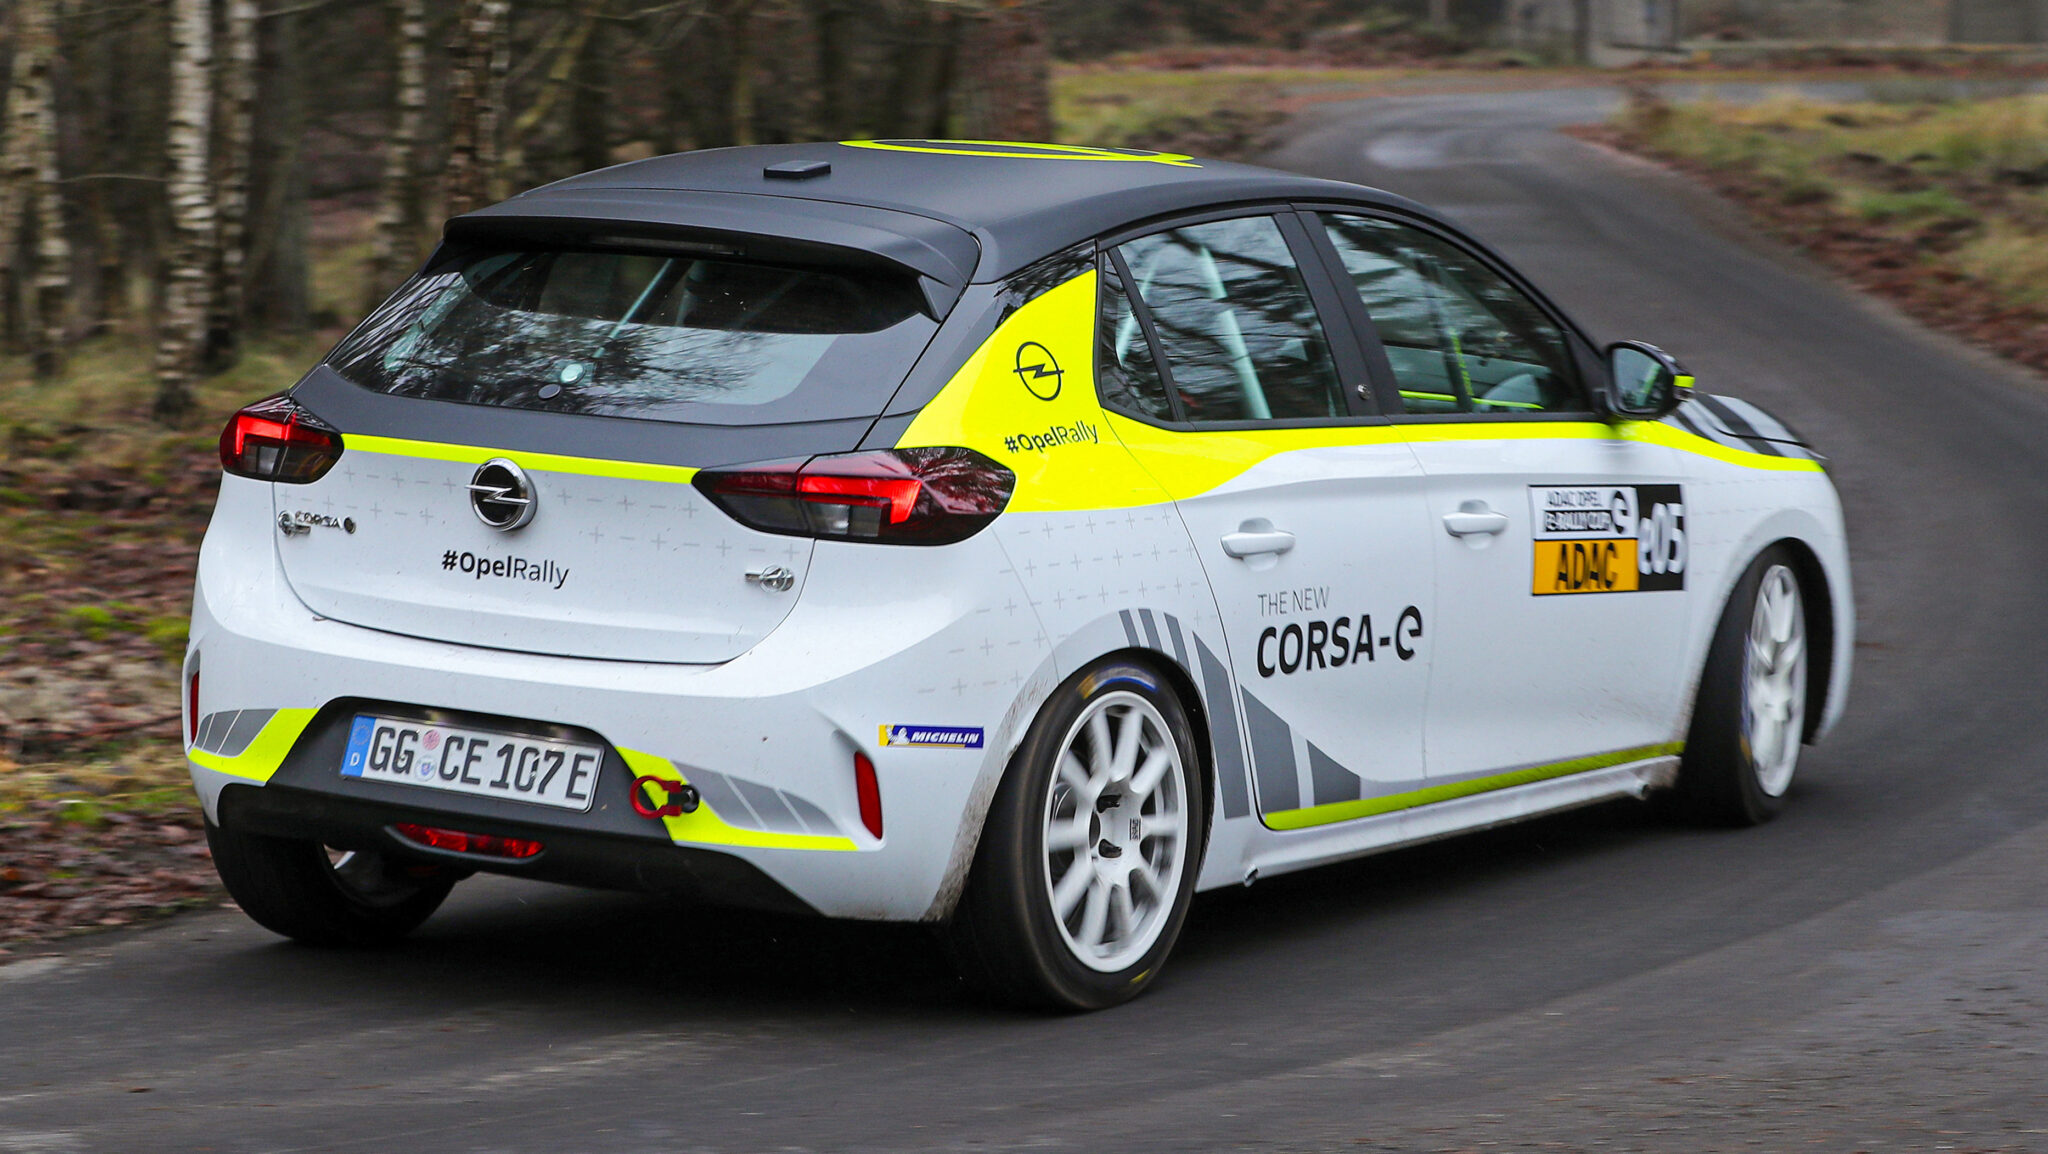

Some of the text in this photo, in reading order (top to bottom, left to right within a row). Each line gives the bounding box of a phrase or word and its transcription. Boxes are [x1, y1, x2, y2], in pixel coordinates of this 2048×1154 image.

[1004, 420, 1098, 454] #OpelRally
[441, 549, 570, 590] #OpelRally
[1554, 542, 1619, 592] ADAC
[1257, 585, 1331, 617] THE NEW
[368, 726, 420, 775] GG
[438, 735, 490, 786] CE
[911, 731, 980, 744] MICHELIN
